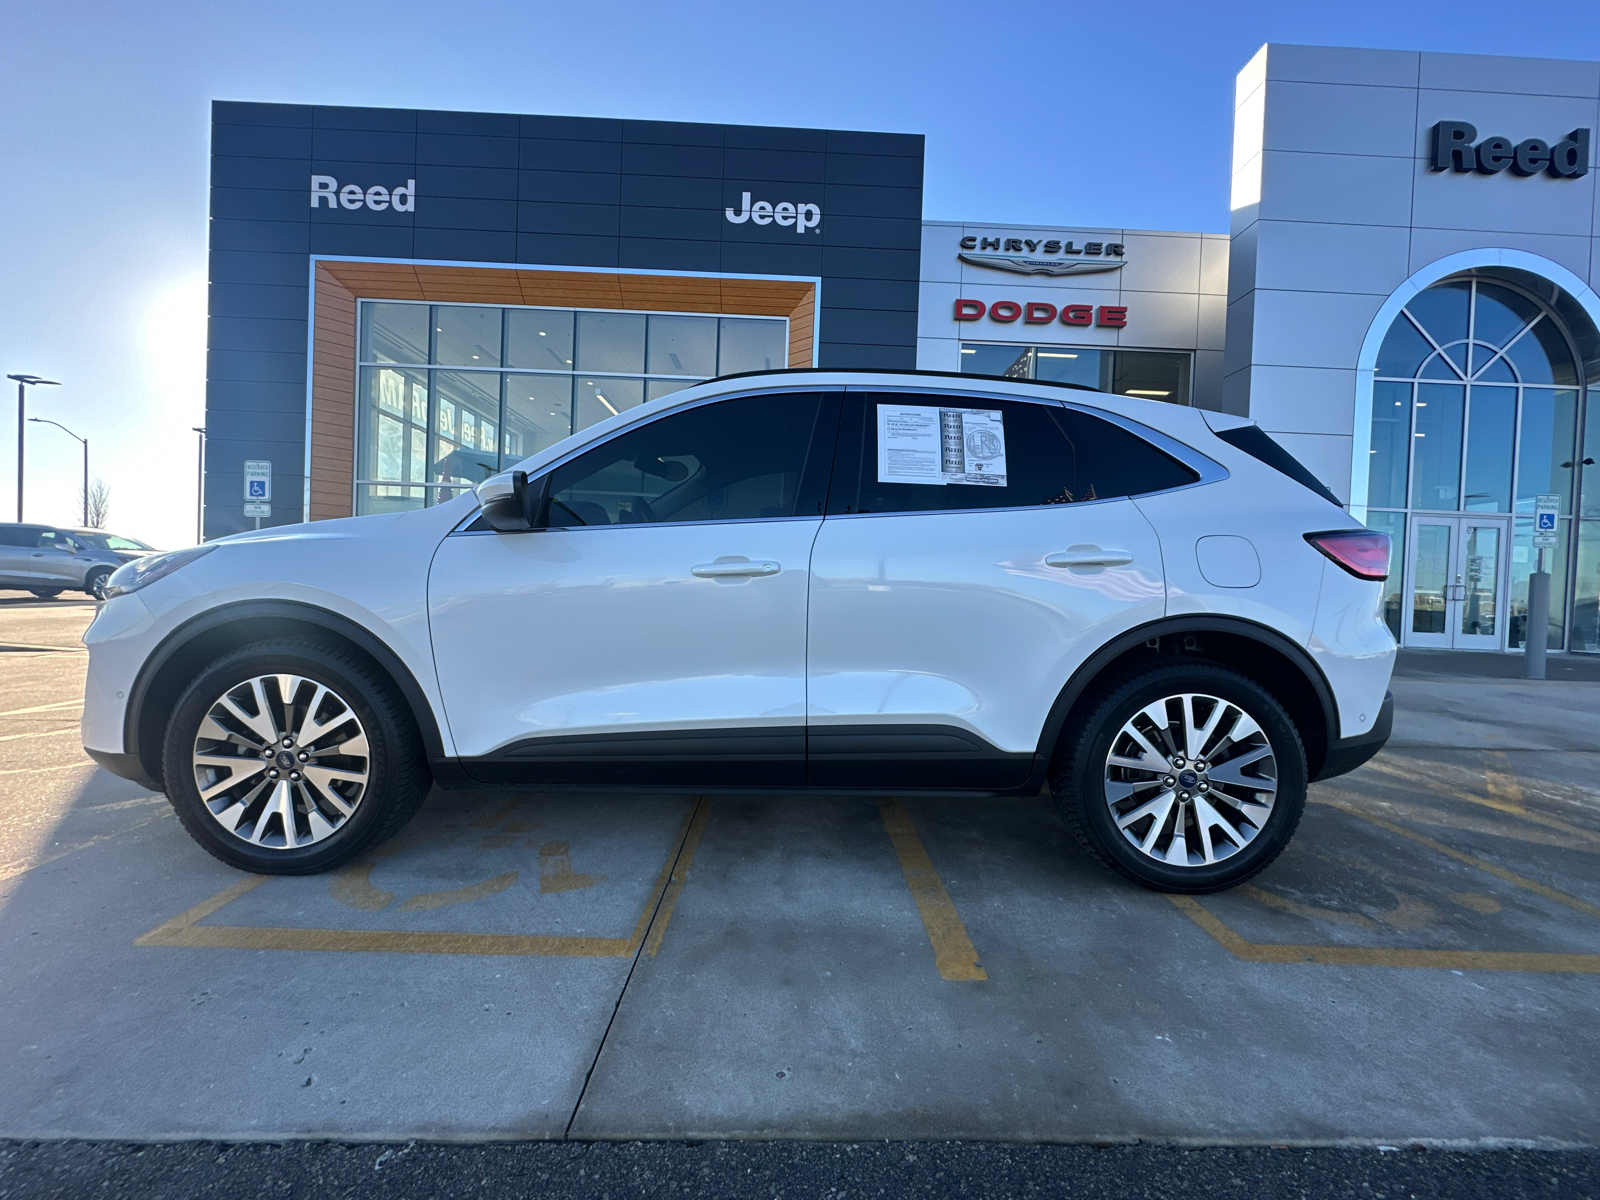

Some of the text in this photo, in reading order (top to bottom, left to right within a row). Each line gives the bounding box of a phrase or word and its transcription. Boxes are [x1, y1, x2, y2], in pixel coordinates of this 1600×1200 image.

[1431, 120, 1591, 180] Reed
[310, 174, 416, 212] Reed
[725, 191, 821, 234] Jeep
[960, 236, 1125, 255] CHRYSLER
[954, 298, 1128, 328] DODGE
